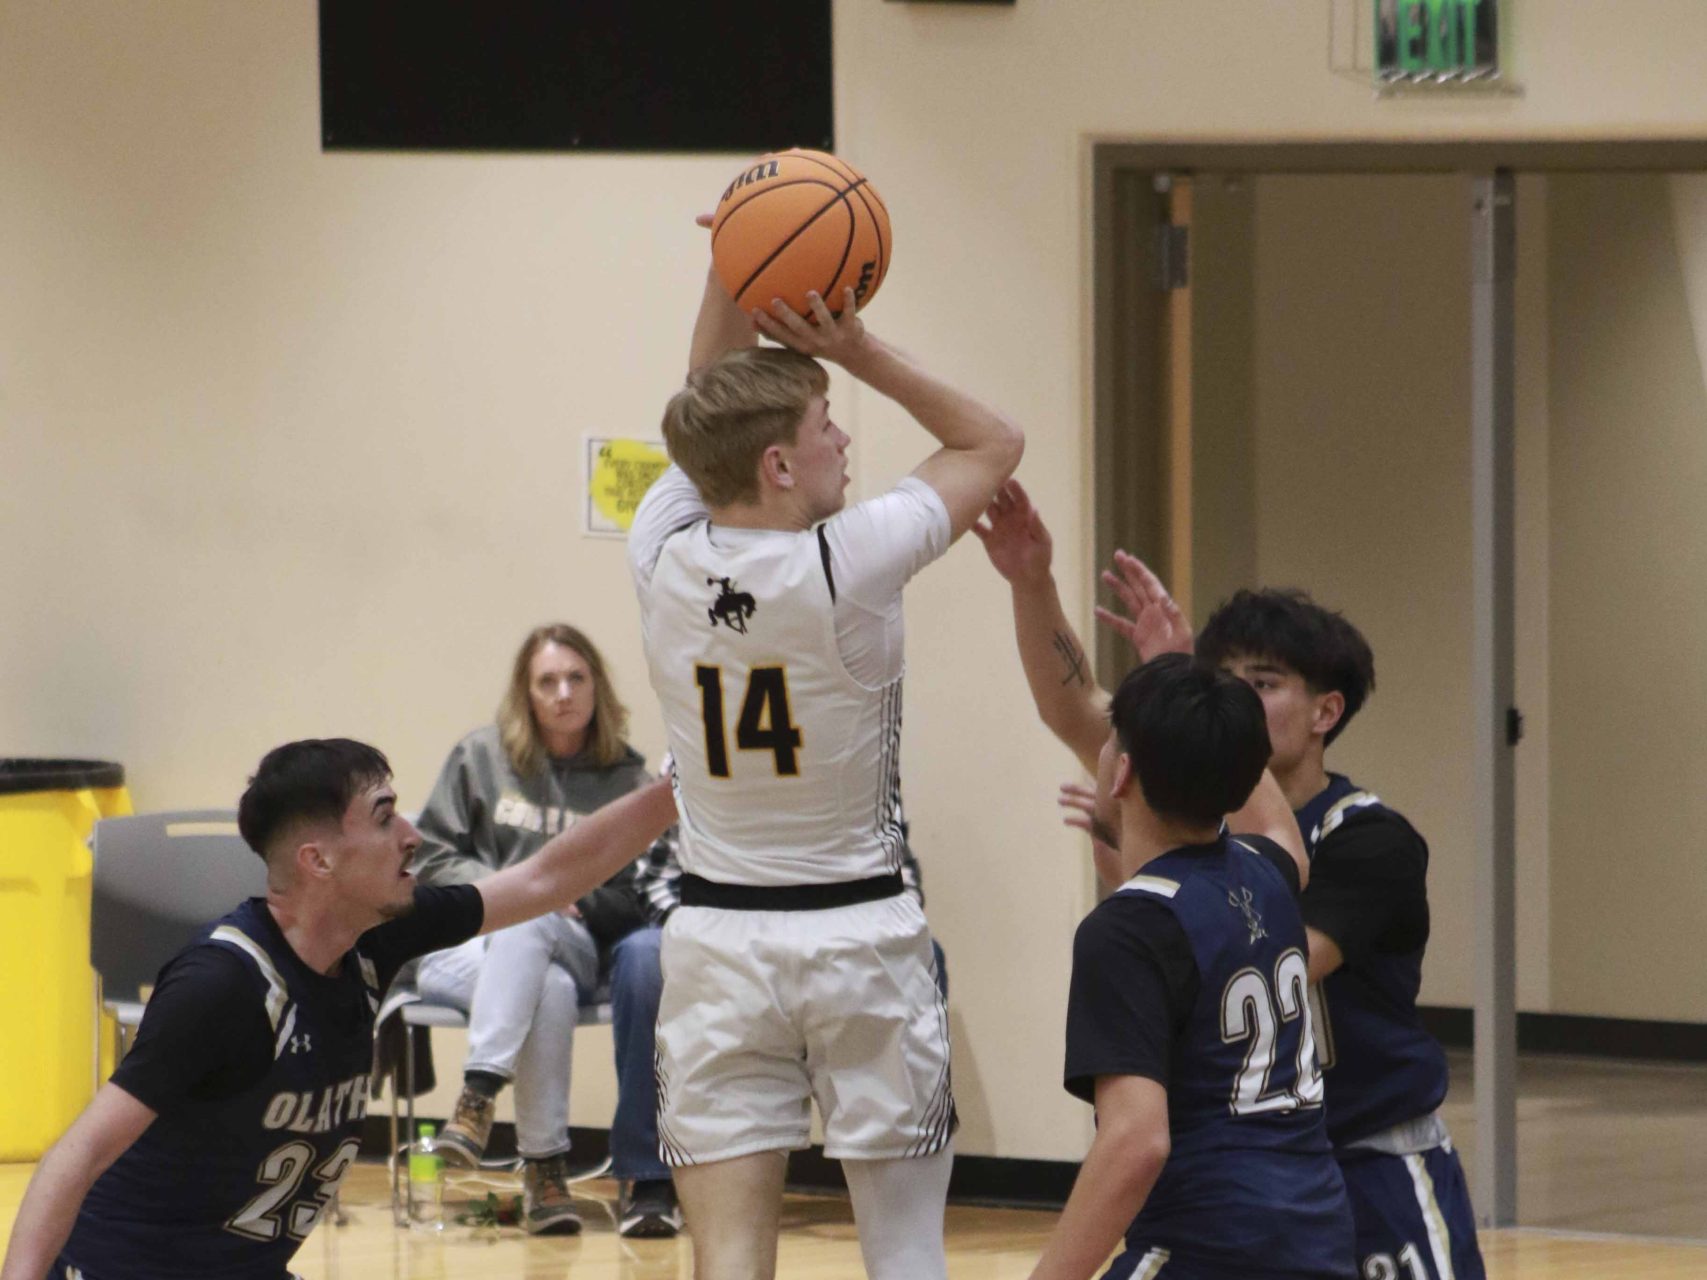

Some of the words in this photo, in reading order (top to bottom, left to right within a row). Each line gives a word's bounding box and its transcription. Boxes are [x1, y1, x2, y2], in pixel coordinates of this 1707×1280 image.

[1397, 0, 1480, 71] EXIT
[692, 662, 804, 779] 14
[1220, 947, 1325, 1116] 22
[262, 1075, 369, 1133] OLATH
